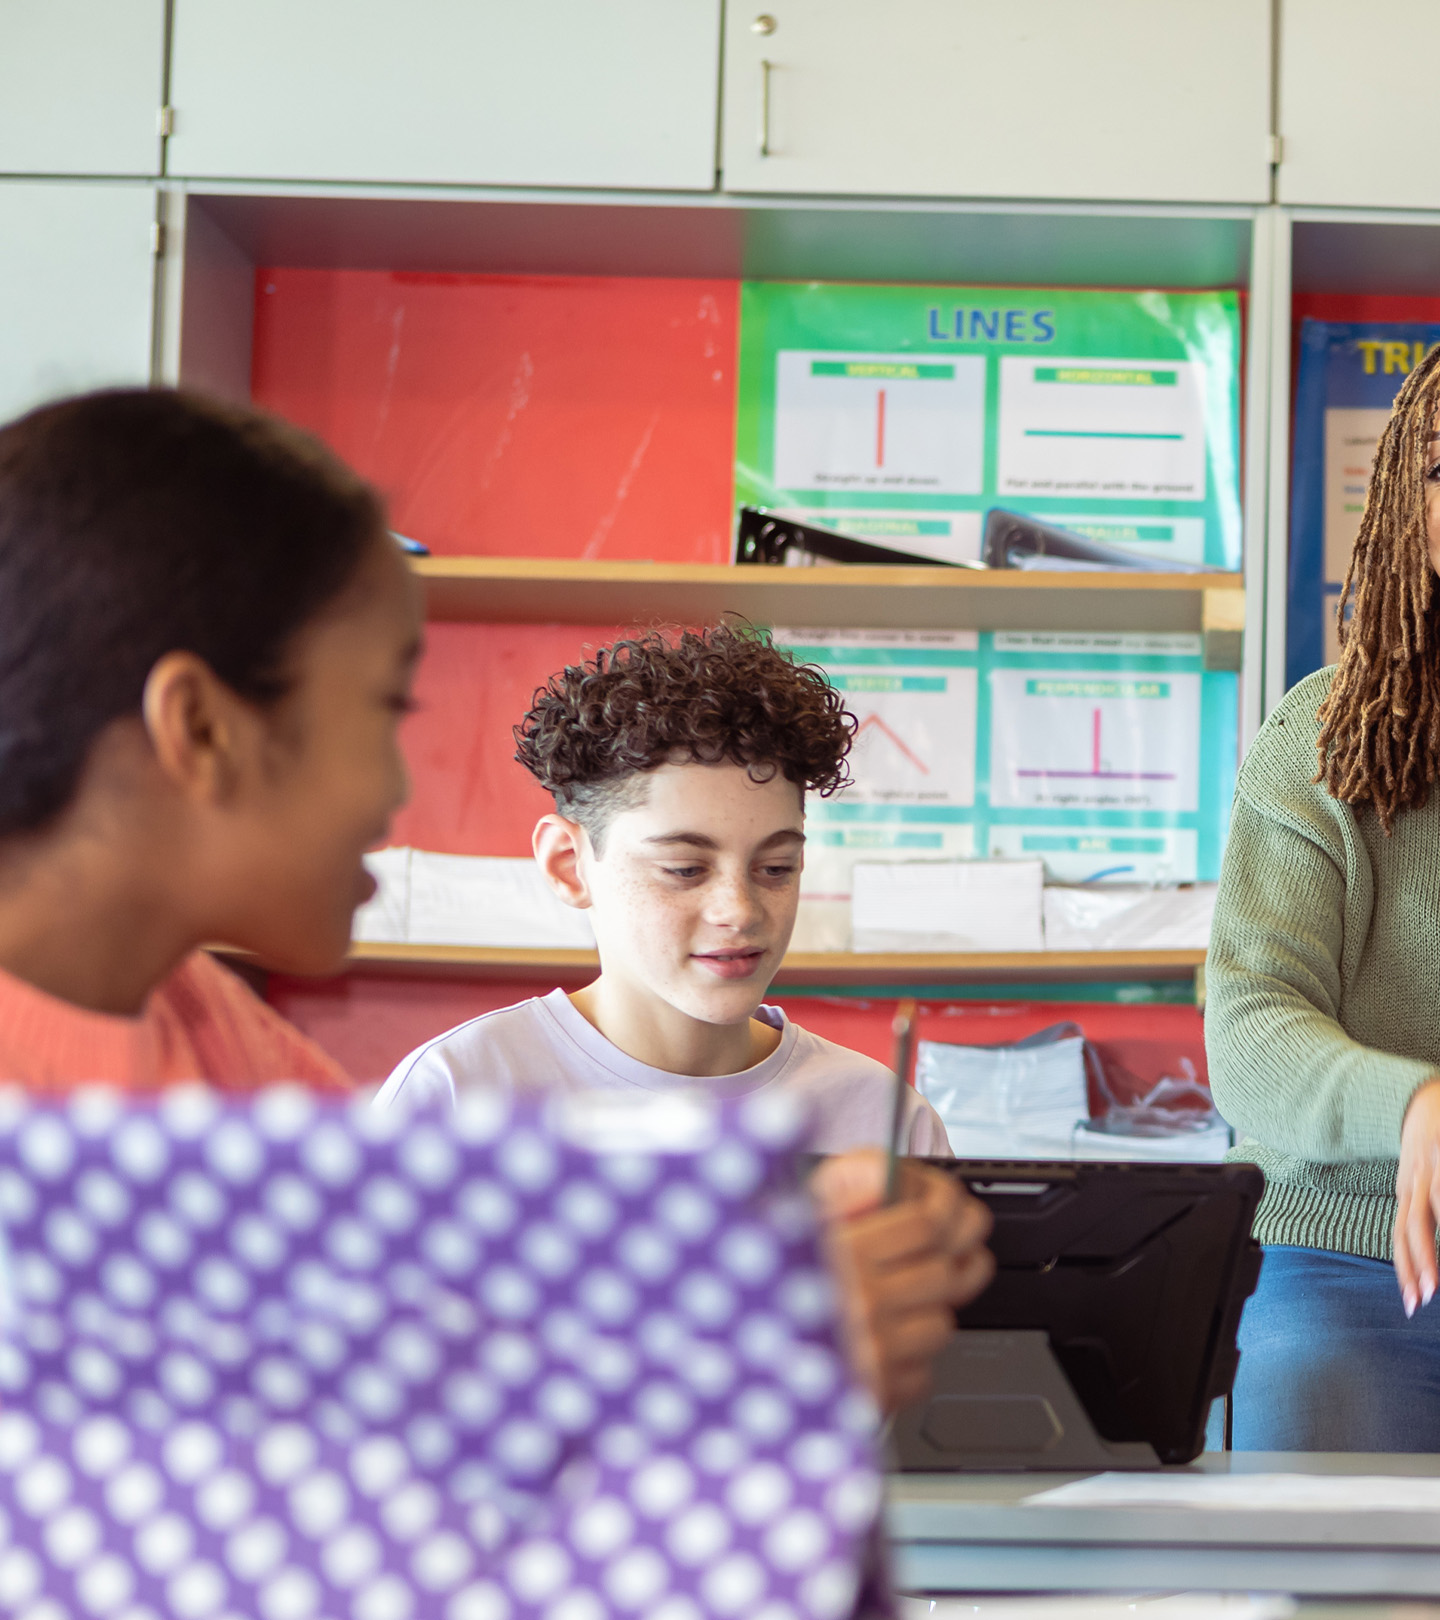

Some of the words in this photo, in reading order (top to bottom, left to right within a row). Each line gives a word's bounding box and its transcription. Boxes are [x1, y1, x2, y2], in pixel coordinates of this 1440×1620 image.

[929, 308, 1056, 344] LINES
[847, 363, 920, 379] VERTICAL
[1057, 369, 1154, 385] HORIZONTAL
[845, 674, 902, 691] VERTEX
[1036, 681, 1161, 698] PERPENDICULAR
